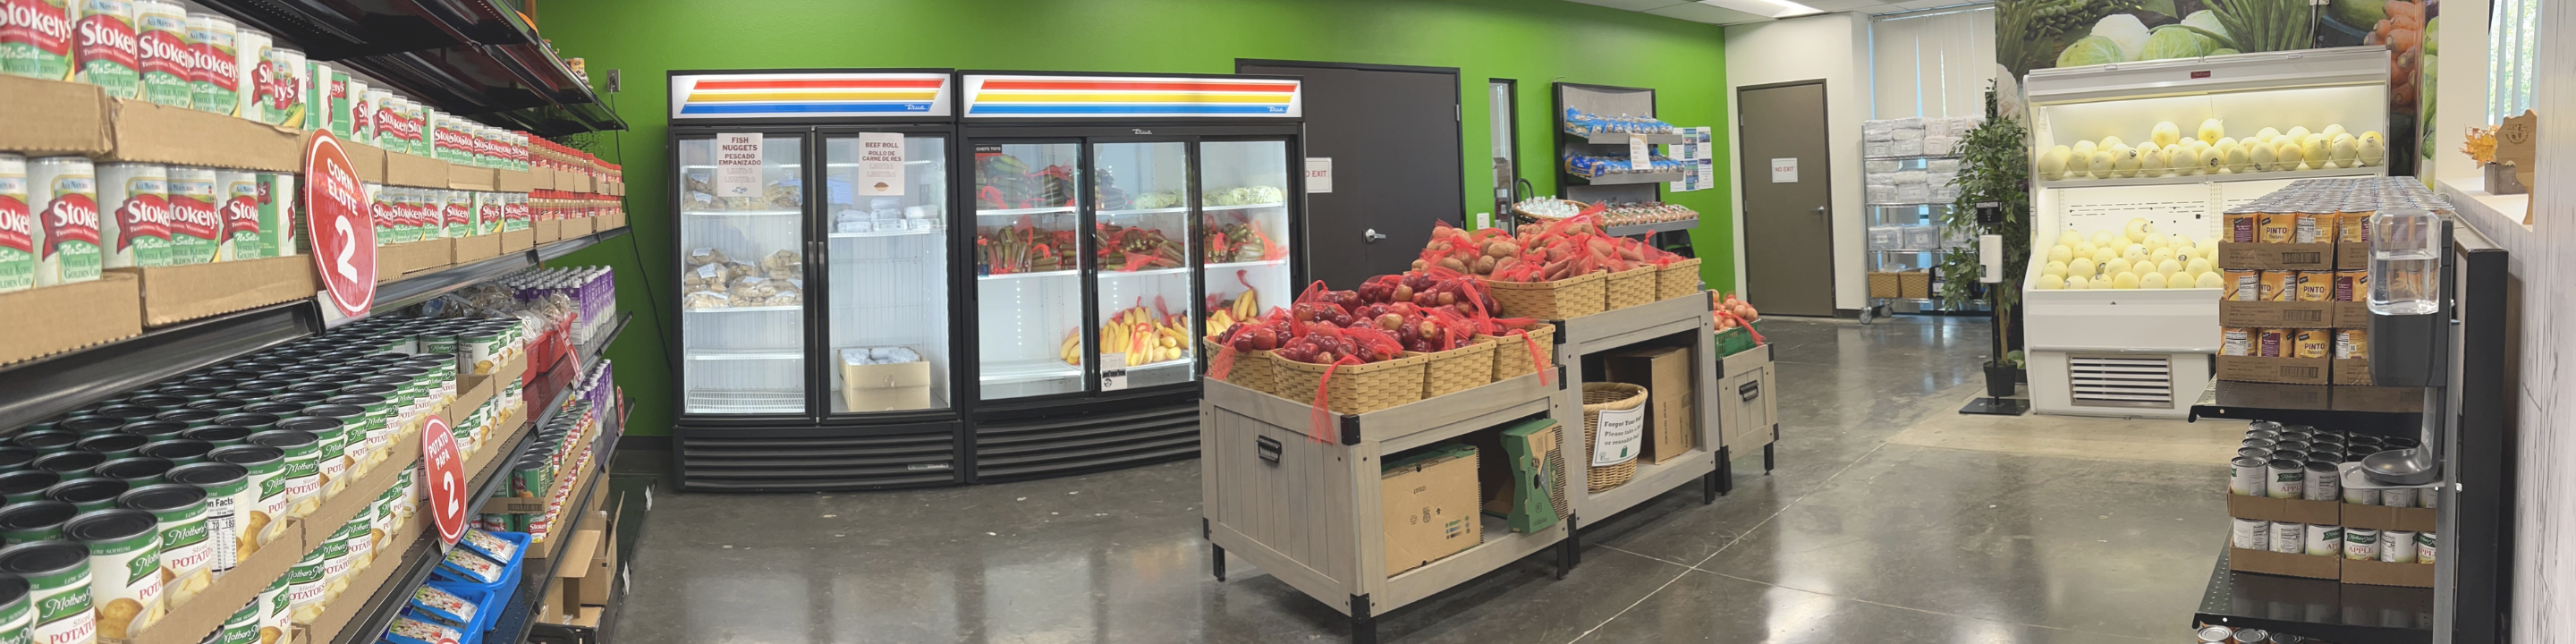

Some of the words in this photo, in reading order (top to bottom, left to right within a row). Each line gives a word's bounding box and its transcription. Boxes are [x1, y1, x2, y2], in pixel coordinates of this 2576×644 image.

[326, 157, 354, 193] CORN
[327, 177, 358, 216] ELOTE
[335, 215, 358, 284] 2
[1604, 420, 1624, 428] Forgot
[428, 431, 449, 459] POTATO
[1612, 436, 1632, 445] reusable
[435, 448, 450, 470] PAPA
[216, 497, 233, 508] Facts
[443, 470, 459, 520] 2
